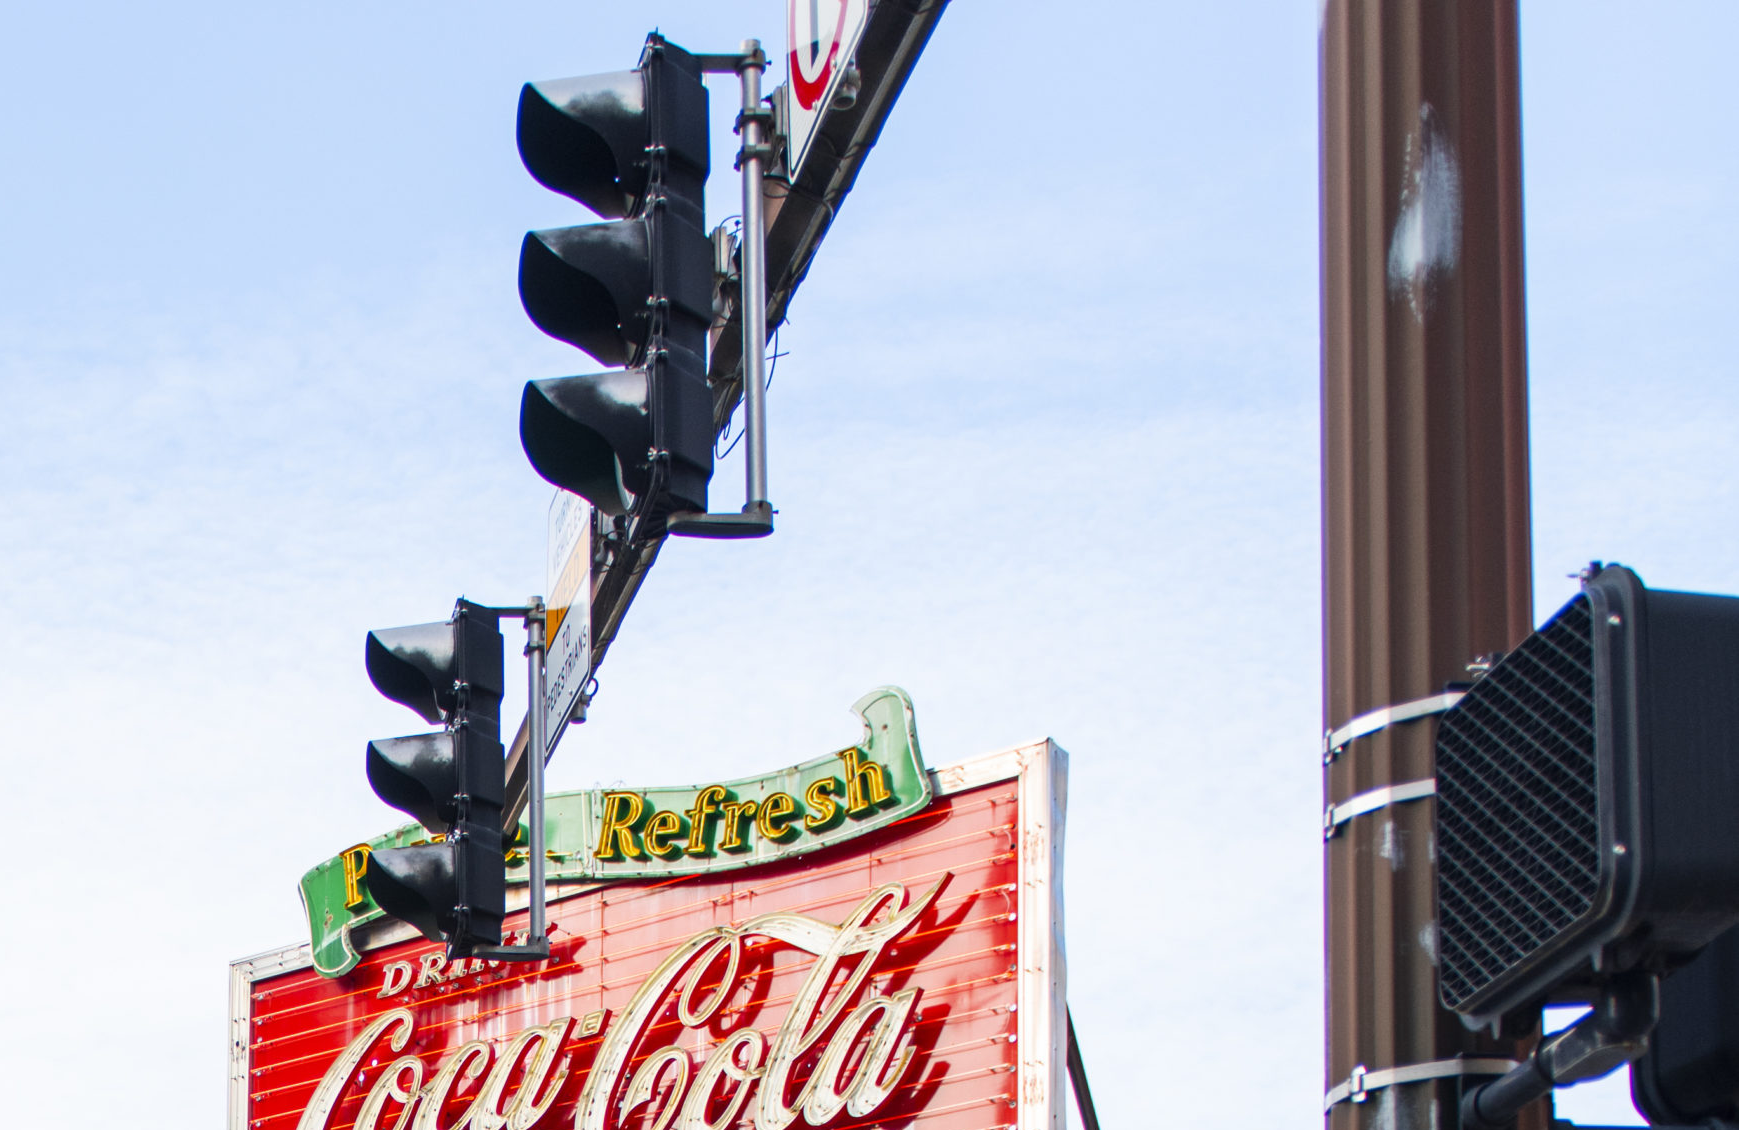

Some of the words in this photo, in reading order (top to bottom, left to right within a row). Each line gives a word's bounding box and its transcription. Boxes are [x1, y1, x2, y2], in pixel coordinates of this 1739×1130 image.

[547, 624, 588, 710] PEDESTRIANS
[561, 624, 571, 655] TO
[593, 746, 891, 859] Refresh
